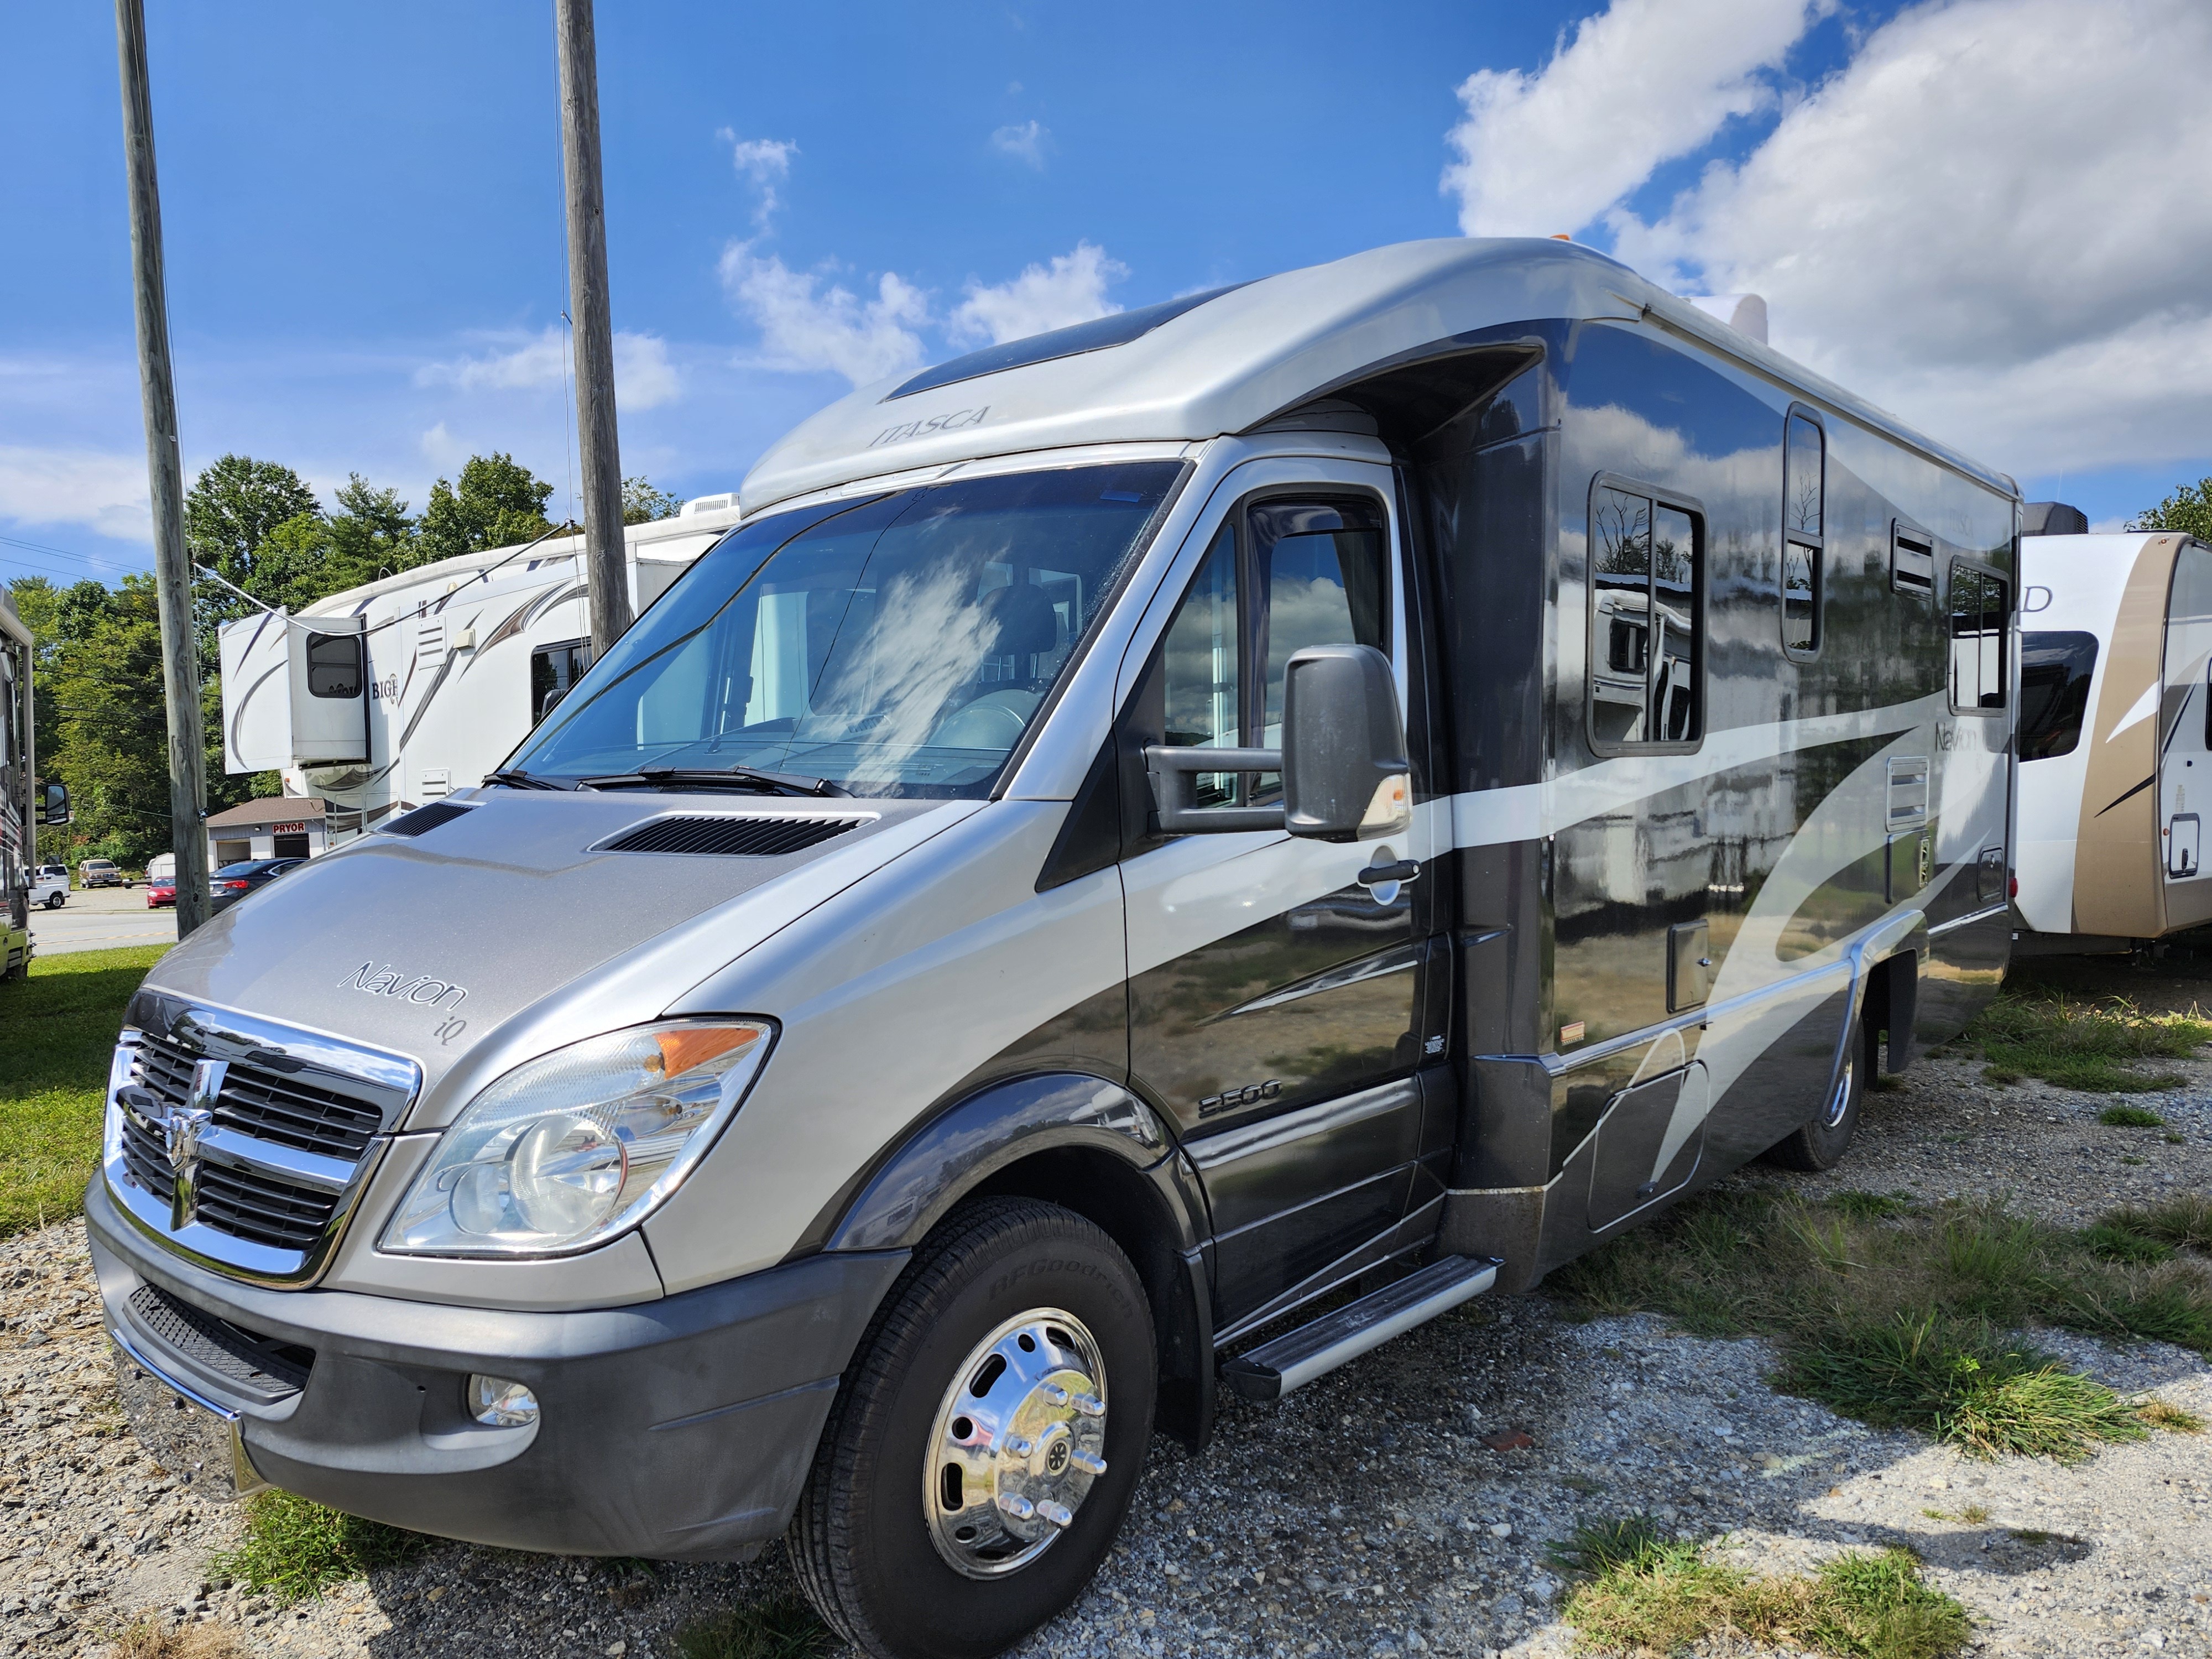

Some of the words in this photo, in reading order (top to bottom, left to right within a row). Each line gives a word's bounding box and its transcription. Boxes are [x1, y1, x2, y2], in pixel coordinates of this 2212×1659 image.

[866, 405, 991, 448] ITASCA
[1935, 721, 1977, 752] Navion
[273, 823, 305, 833] PRYOR
[336, 961, 468, 1011] Navion
[434, 1016, 467, 1046] iQ
